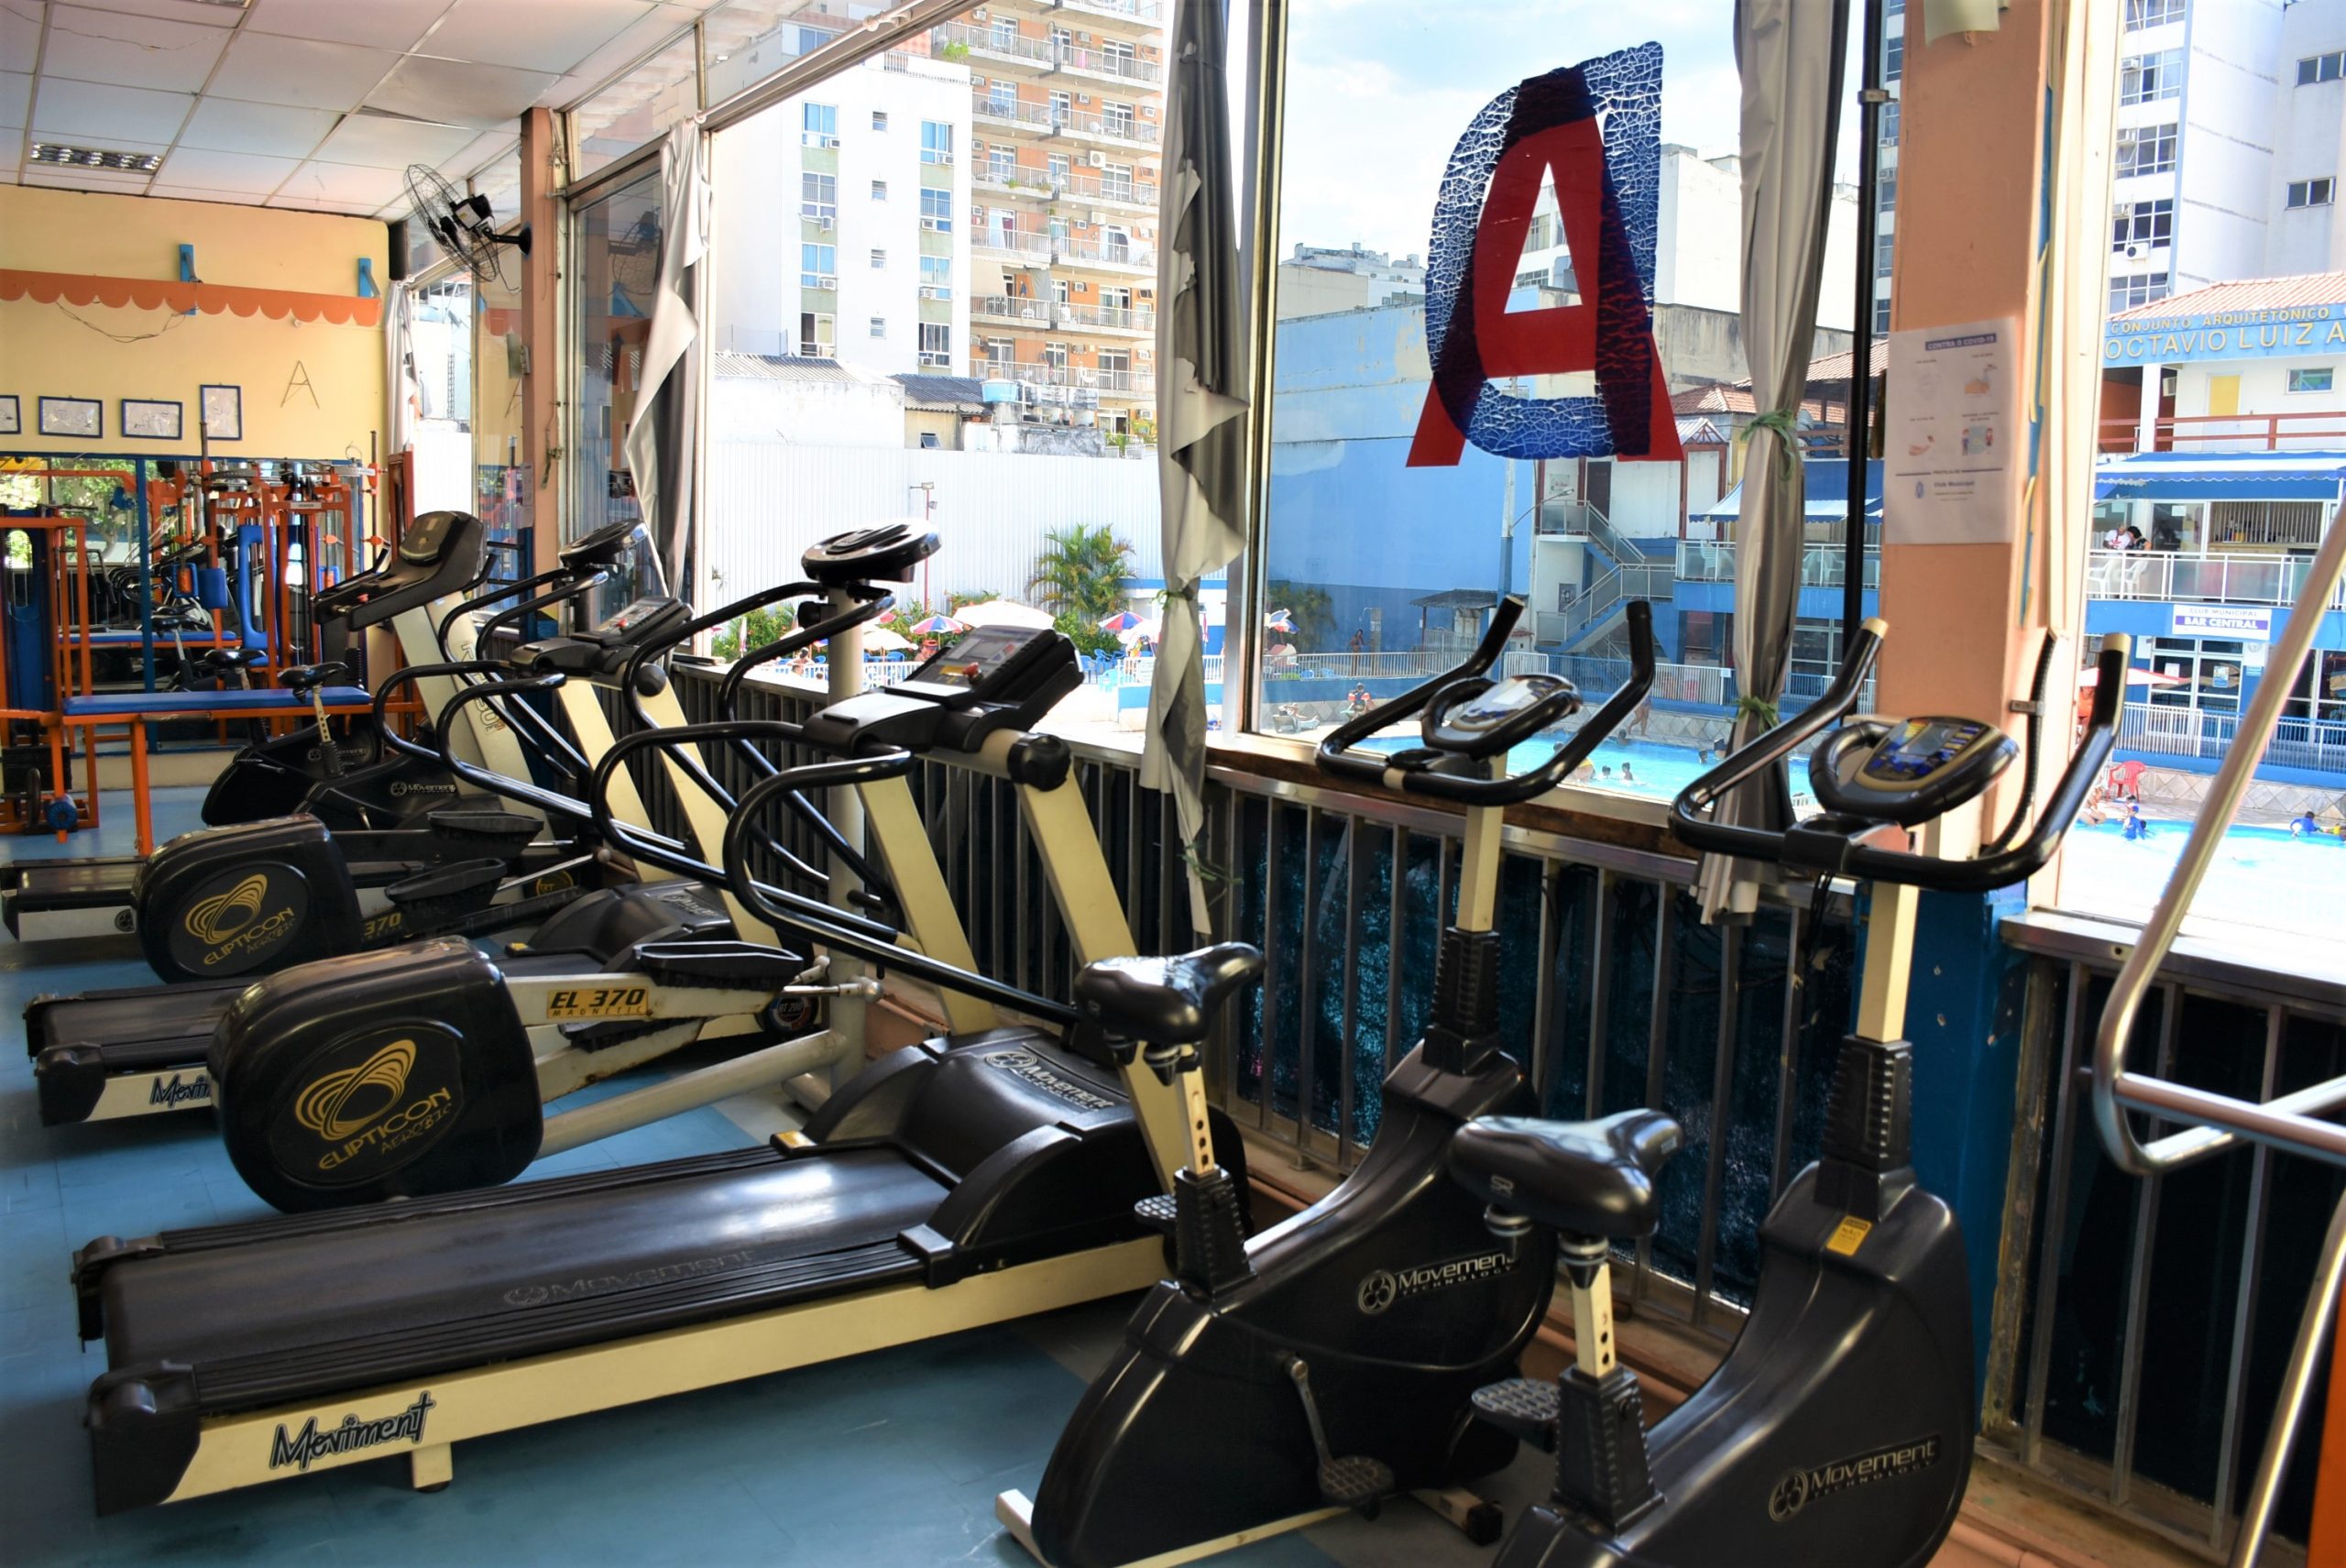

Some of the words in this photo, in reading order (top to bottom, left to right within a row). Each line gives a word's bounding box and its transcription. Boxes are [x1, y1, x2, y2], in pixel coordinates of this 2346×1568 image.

[2110, 317, 2192, 335] CONJUNTO
[1927, 341, 1956, 350] CONTRA
[2105, 329, 2228, 360] OCTAVIO
[2240, 322, 2314, 349] LUIZ
[2184, 616, 2208, 627] BAR
[2209, 618, 2258, 630] CENTRAL
[203, 906, 294, 965] ELIPTICON
[365, 913, 401, 936] 370
[550, 991, 578, 1009] EL
[589, 988, 646, 1007] 370
[552, 1006, 642, 1016] MAGNETIC
[1020, 1064, 1115, 1108] Movement
[318, 1086, 452, 1170] ELIPTICON
[1811, 1440, 1936, 1491] Movement
